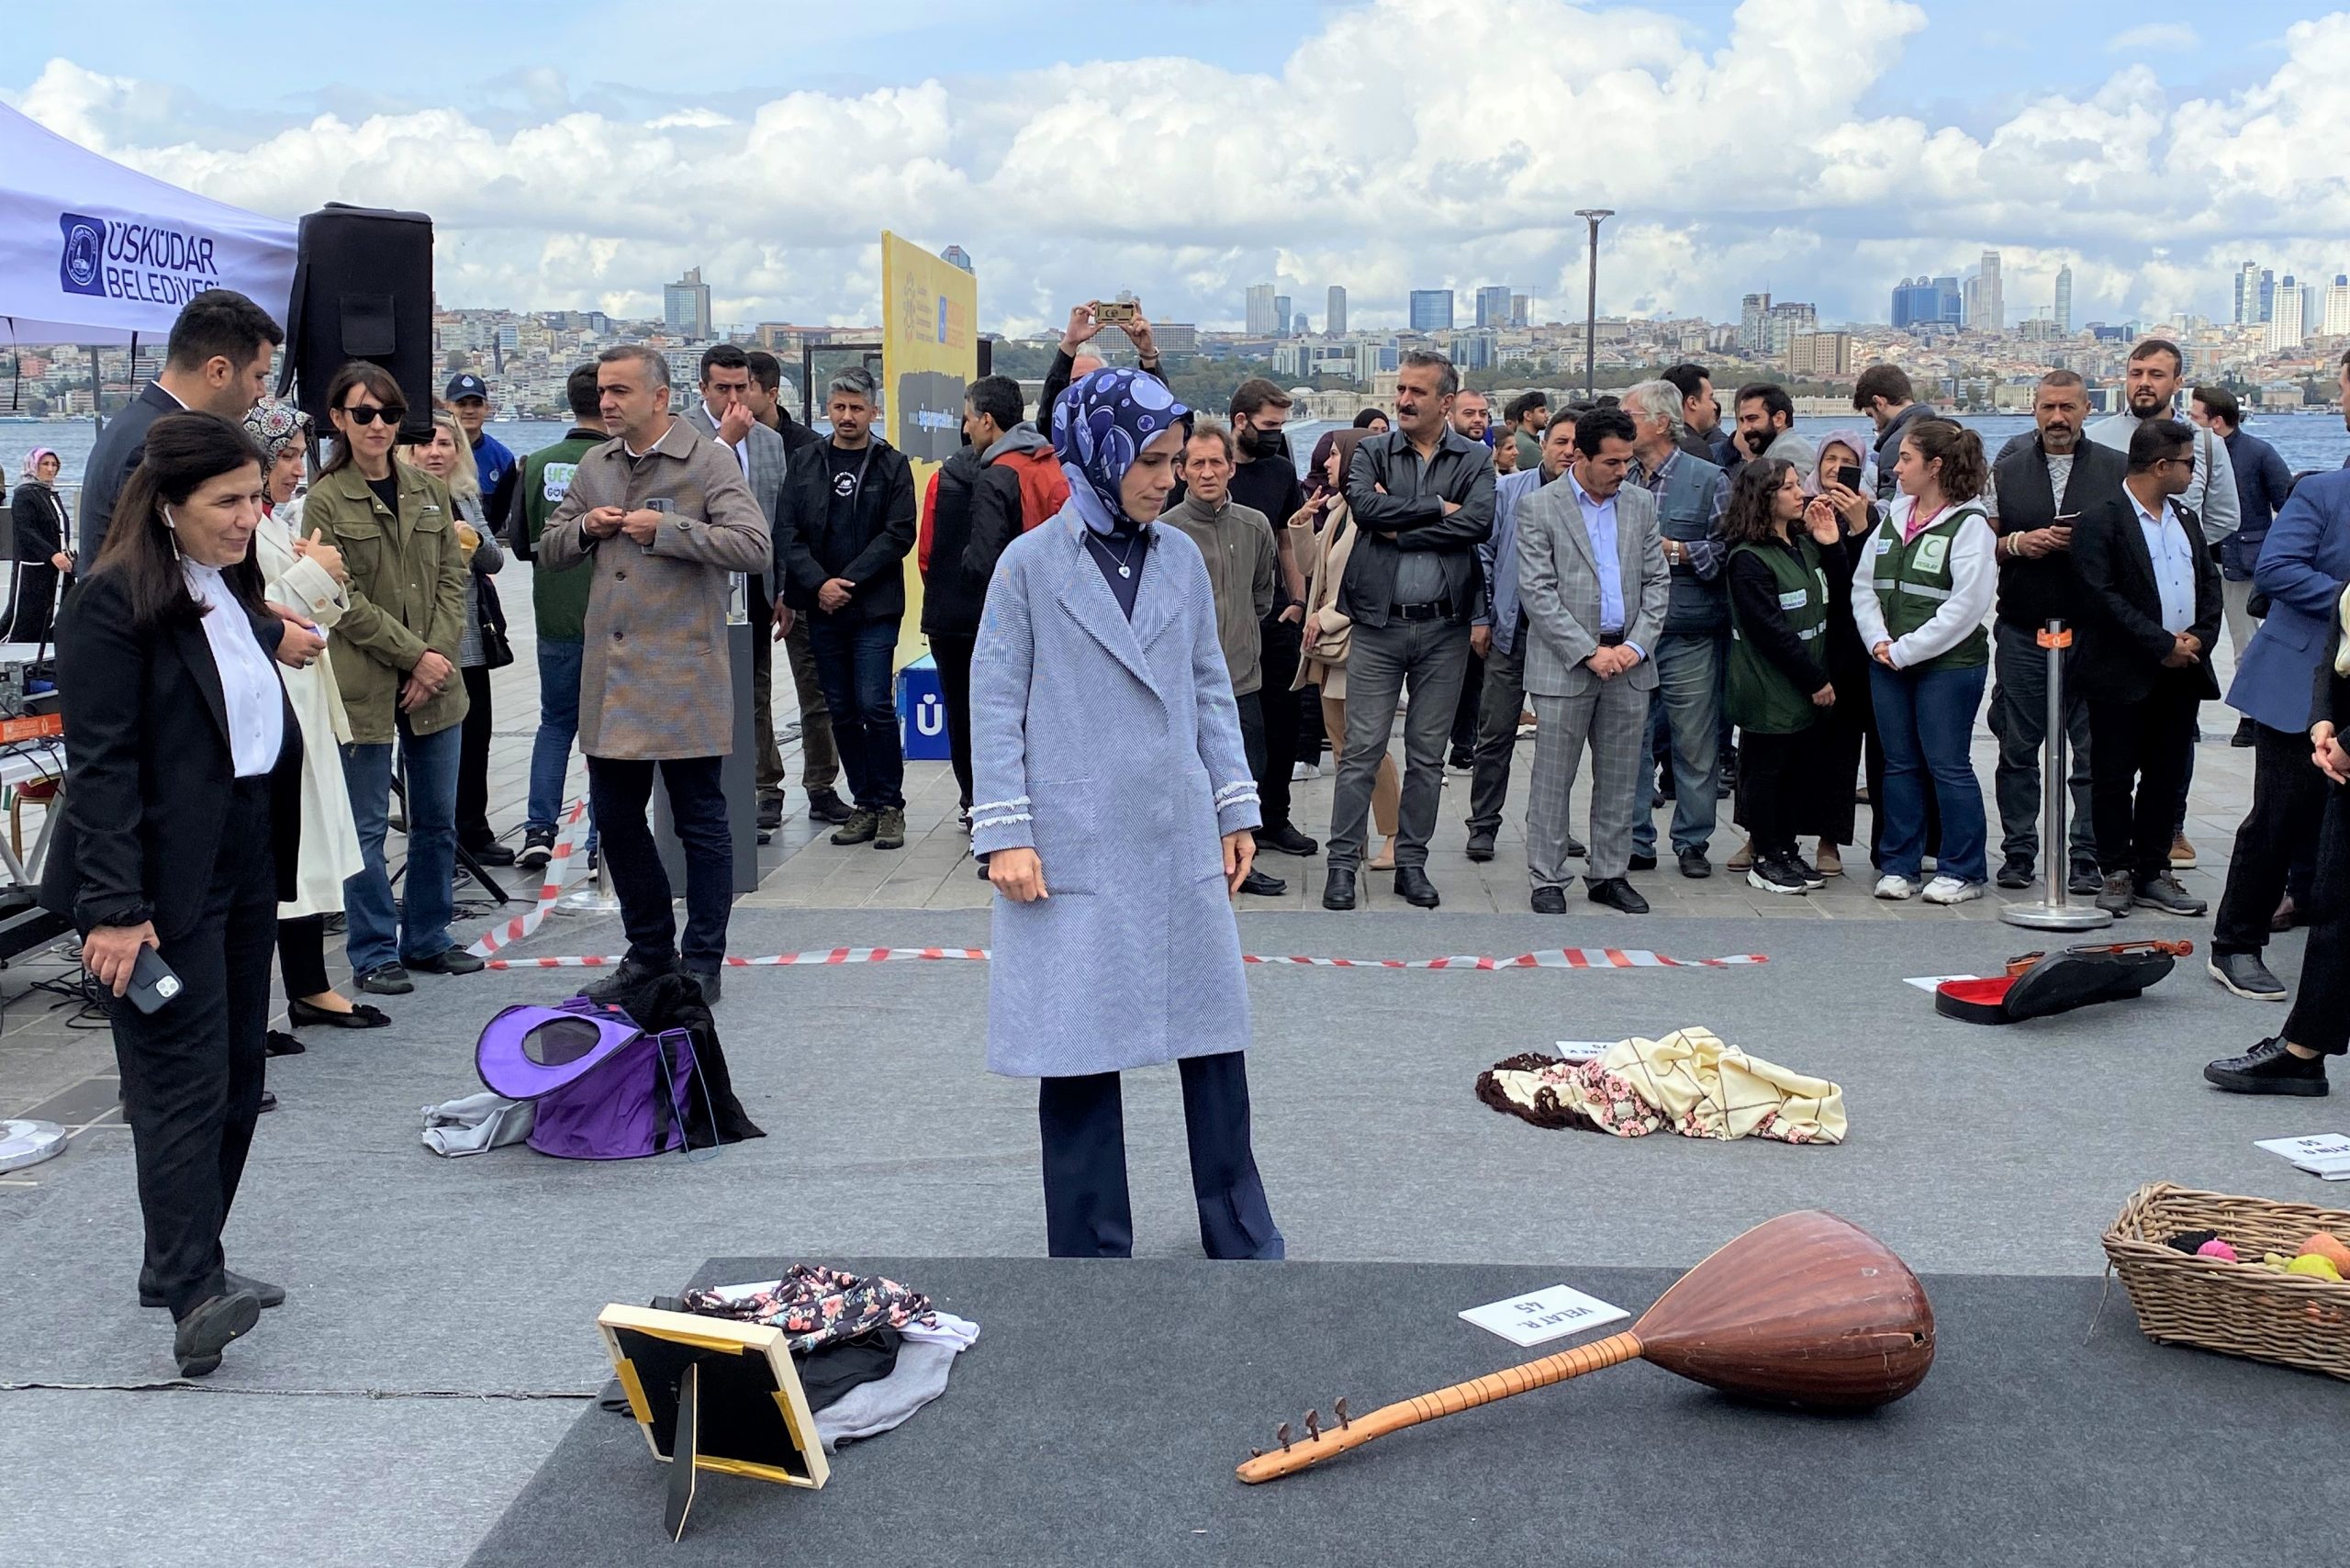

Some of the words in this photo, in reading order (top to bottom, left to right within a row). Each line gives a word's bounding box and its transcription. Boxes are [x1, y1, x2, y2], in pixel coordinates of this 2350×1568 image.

[108, 220, 218, 275] ÜSKÜDAR
[1514, 1301, 1545, 1313] 45
[1540, 1307, 1593, 1325] VELAT
